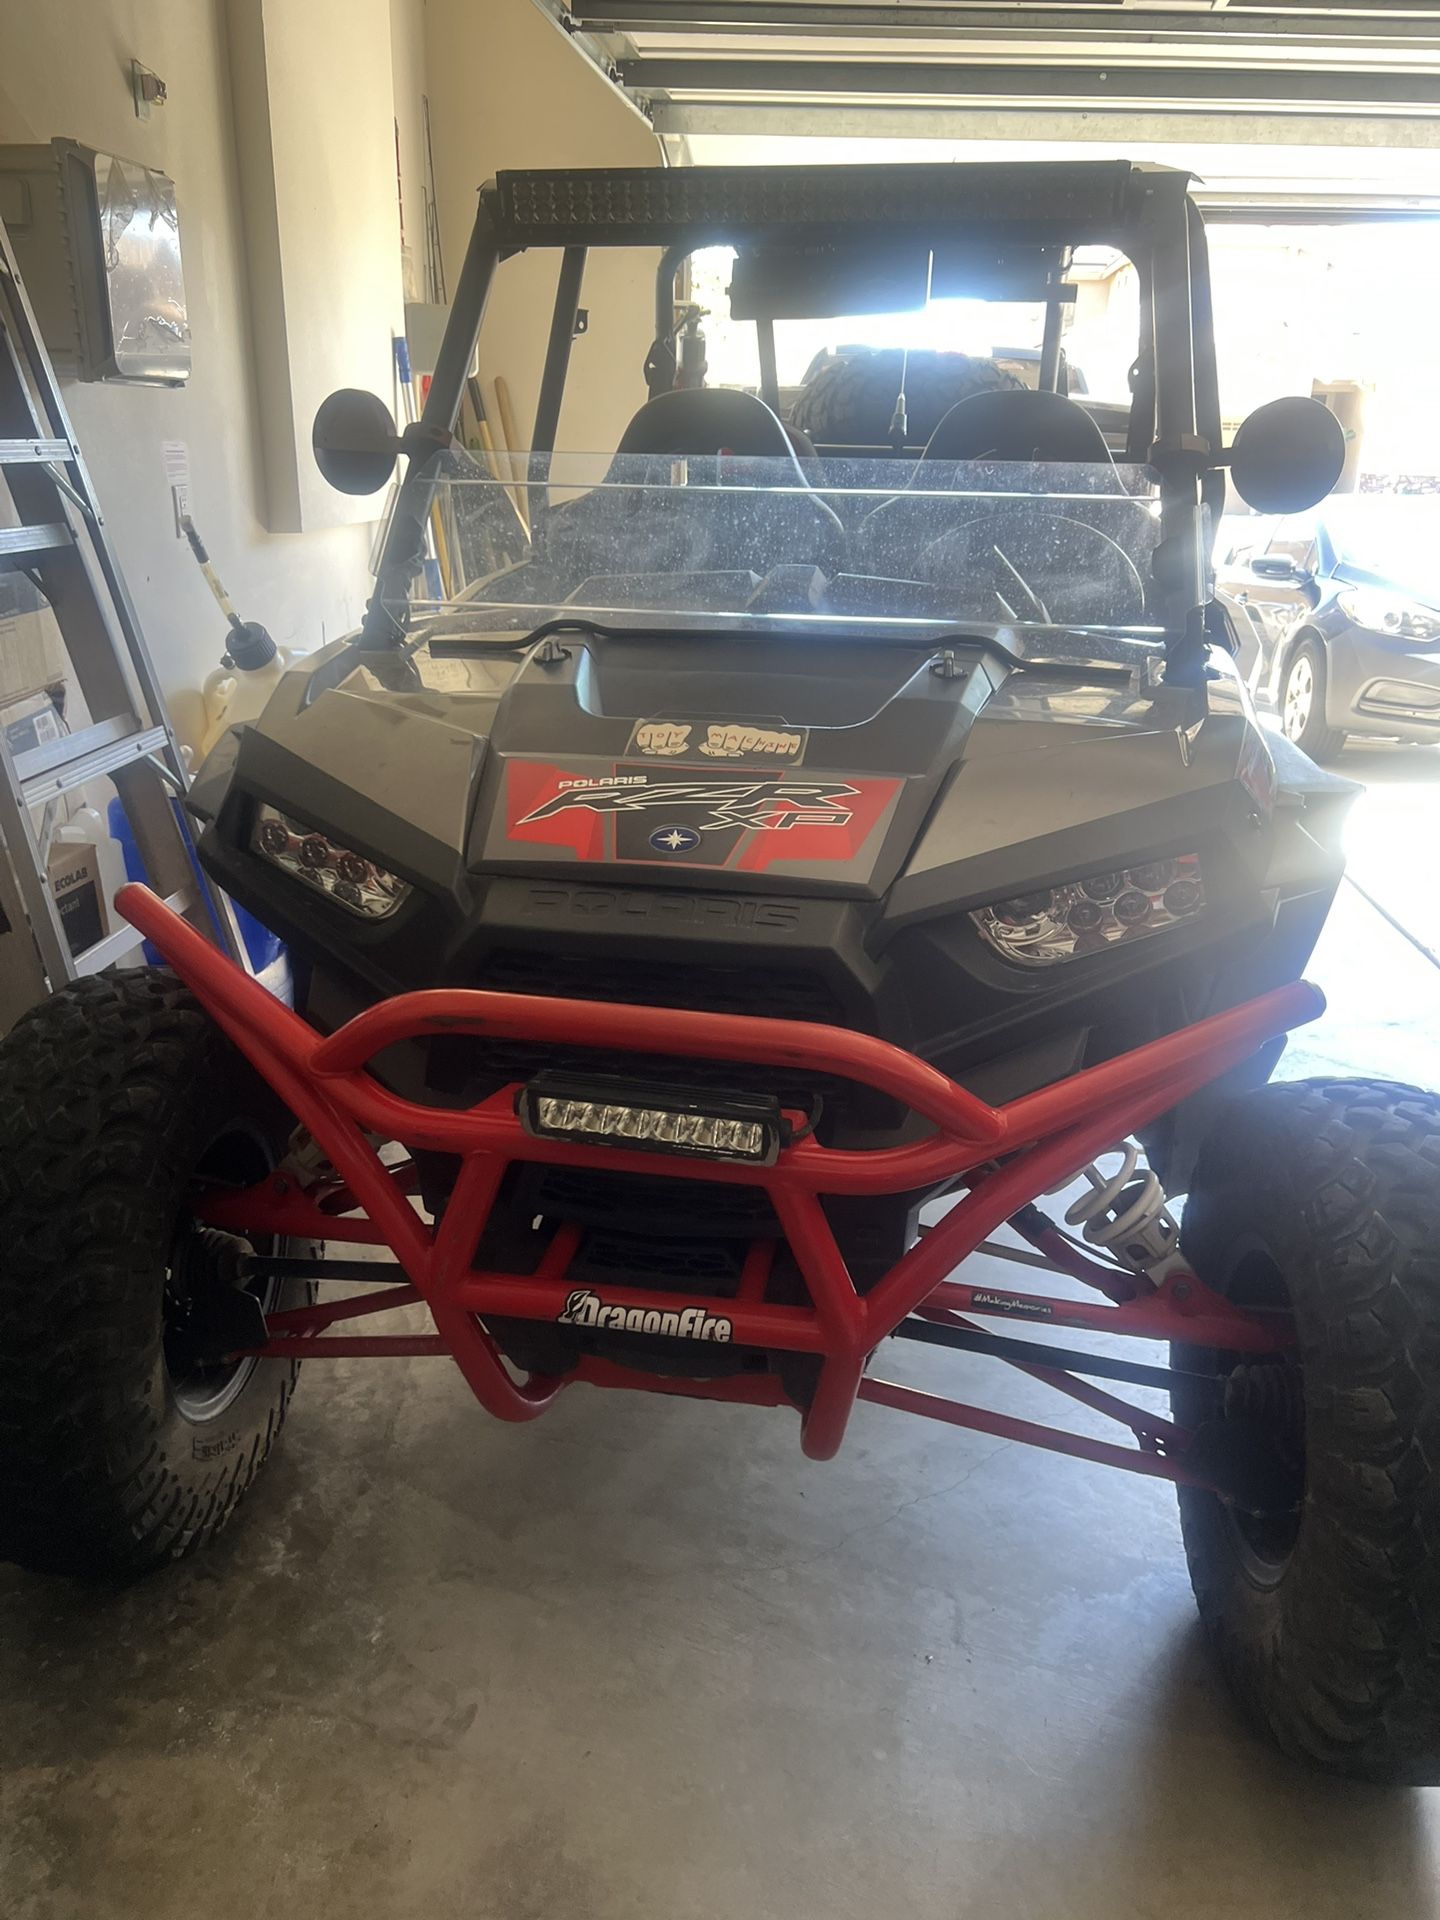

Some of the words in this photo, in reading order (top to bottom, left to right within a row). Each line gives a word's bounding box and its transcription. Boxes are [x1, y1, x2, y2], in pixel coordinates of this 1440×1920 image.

[710, 730, 798, 750] MACHINE
[558, 775, 648, 790] POLARIS
[515, 781, 862, 825] RZR
[699, 811, 854, 830] XP
[54, 866, 89, 893] ECOLAB
[527, 888, 801, 930] POLARIS
